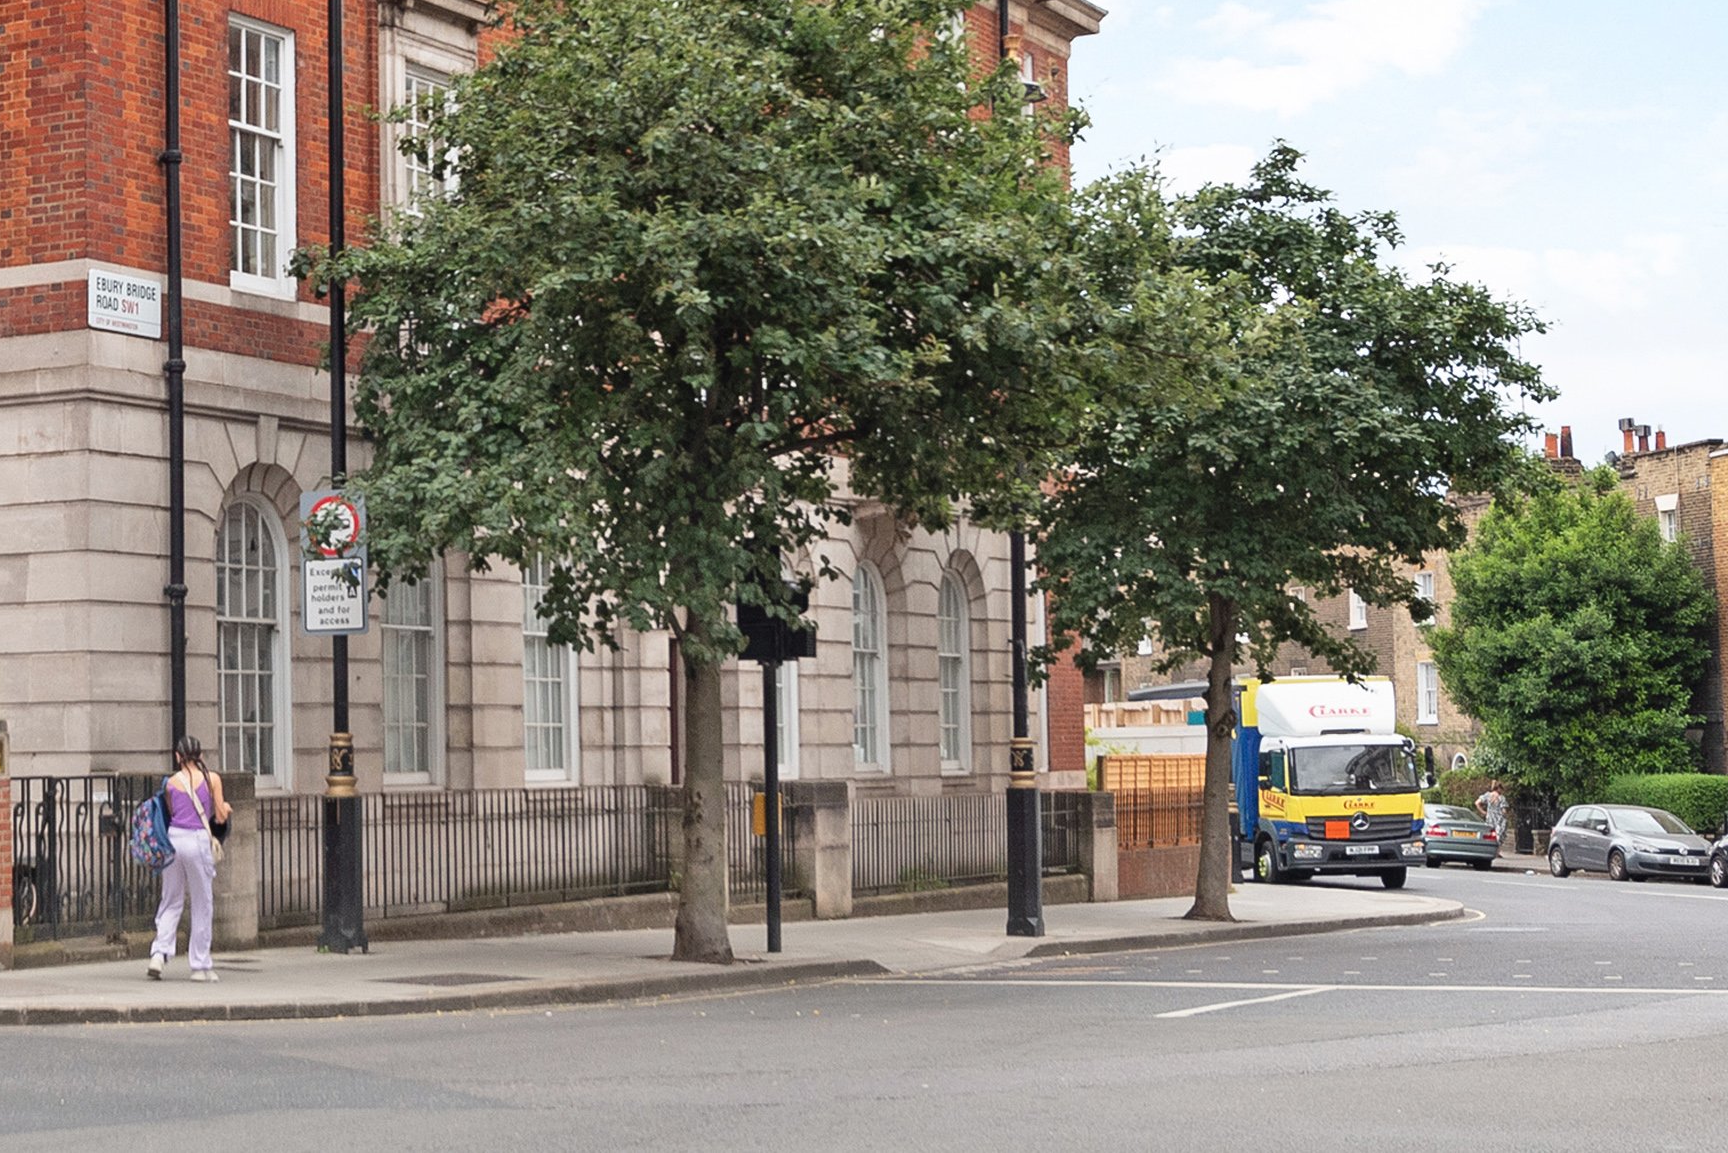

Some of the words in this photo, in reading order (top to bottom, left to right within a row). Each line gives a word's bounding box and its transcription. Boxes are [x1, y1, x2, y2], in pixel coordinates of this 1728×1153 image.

[97, 276, 123, 295] EBURY
[126, 282, 156, 302] BRIDGE
[96, 294, 119, 312] ROAD
[121, 298, 139, 316] SW1
[309, 568, 334, 577] Exce
[312, 583, 342, 593] permit
[311, 594, 344, 602] holders
[318, 606, 334, 614] and
[337, 605, 350, 614] for
[319, 617, 350, 625] access
